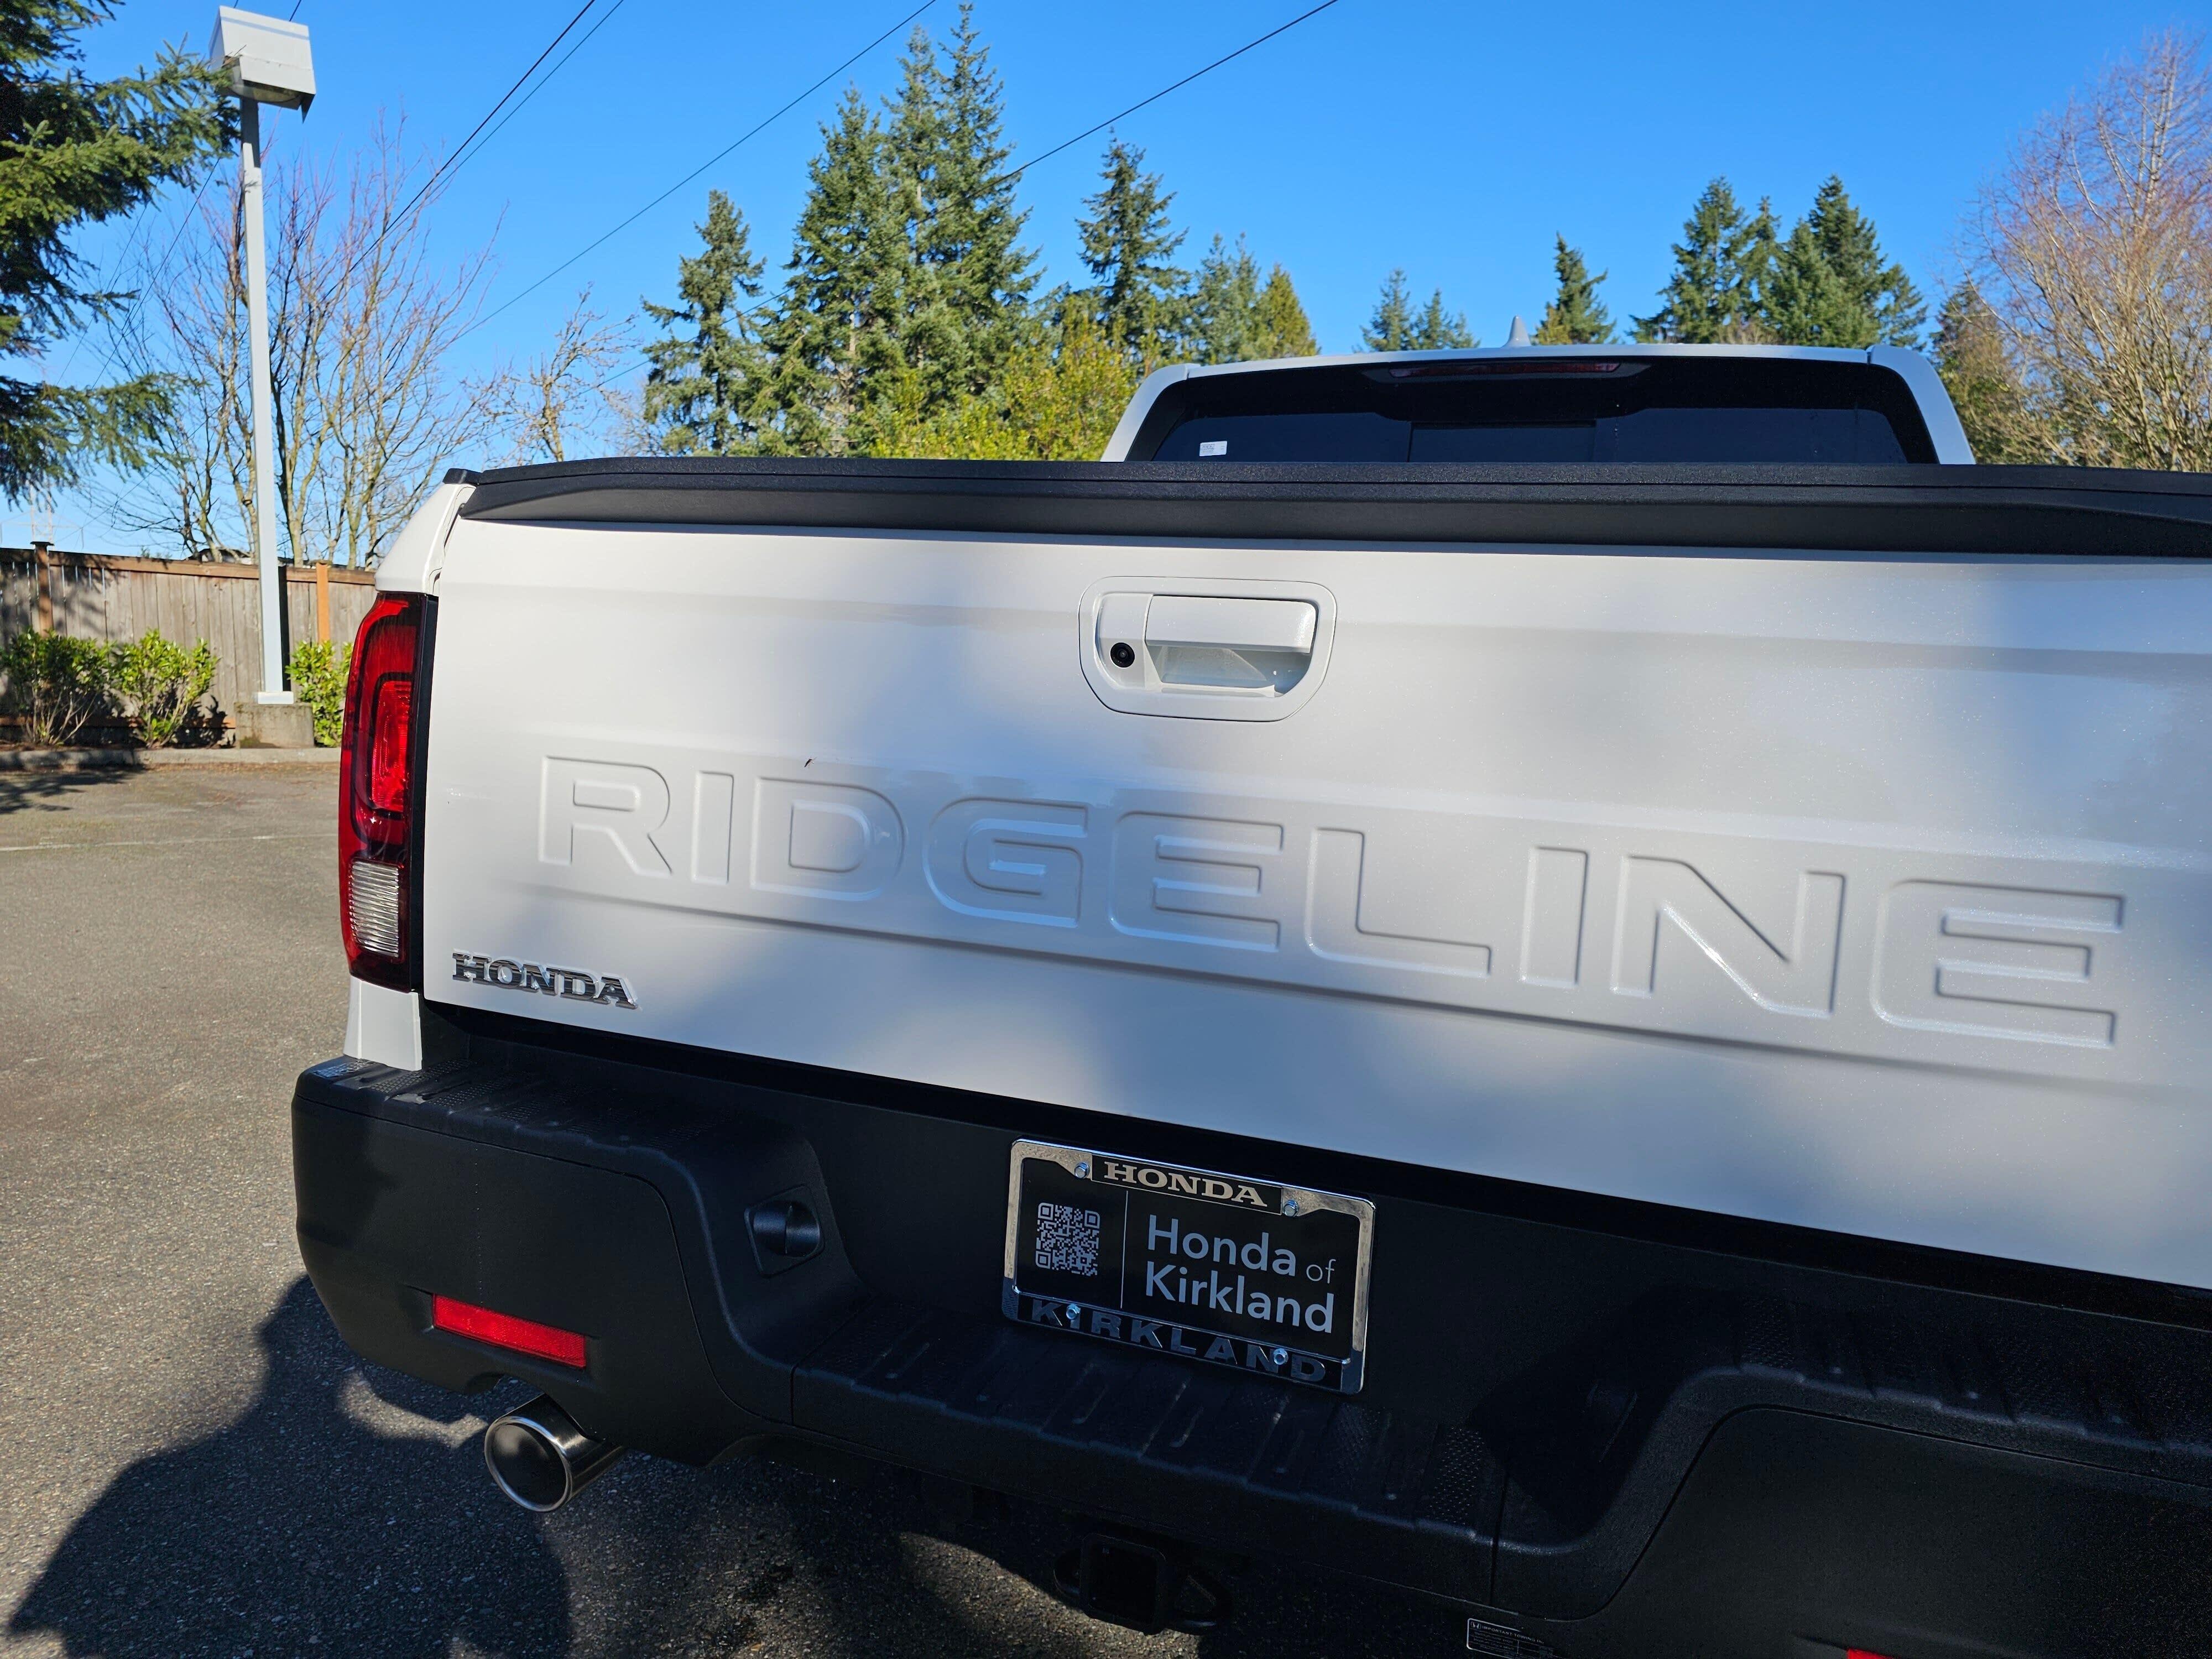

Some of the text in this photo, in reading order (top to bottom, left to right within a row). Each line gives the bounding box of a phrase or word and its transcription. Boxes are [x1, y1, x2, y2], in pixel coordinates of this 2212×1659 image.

[538, 754, 2125, 1050] RIDGELINE
[452, 948, 639, 1010] HONDA
[1103, 1161, 1267, 1208] HONDA
[1147, 1214, 1337, 1284] Honda of
[1145, 1261, 1335, 1334] Kirkland
[1031, 1298, 1327, 1383] KIRKLAND
